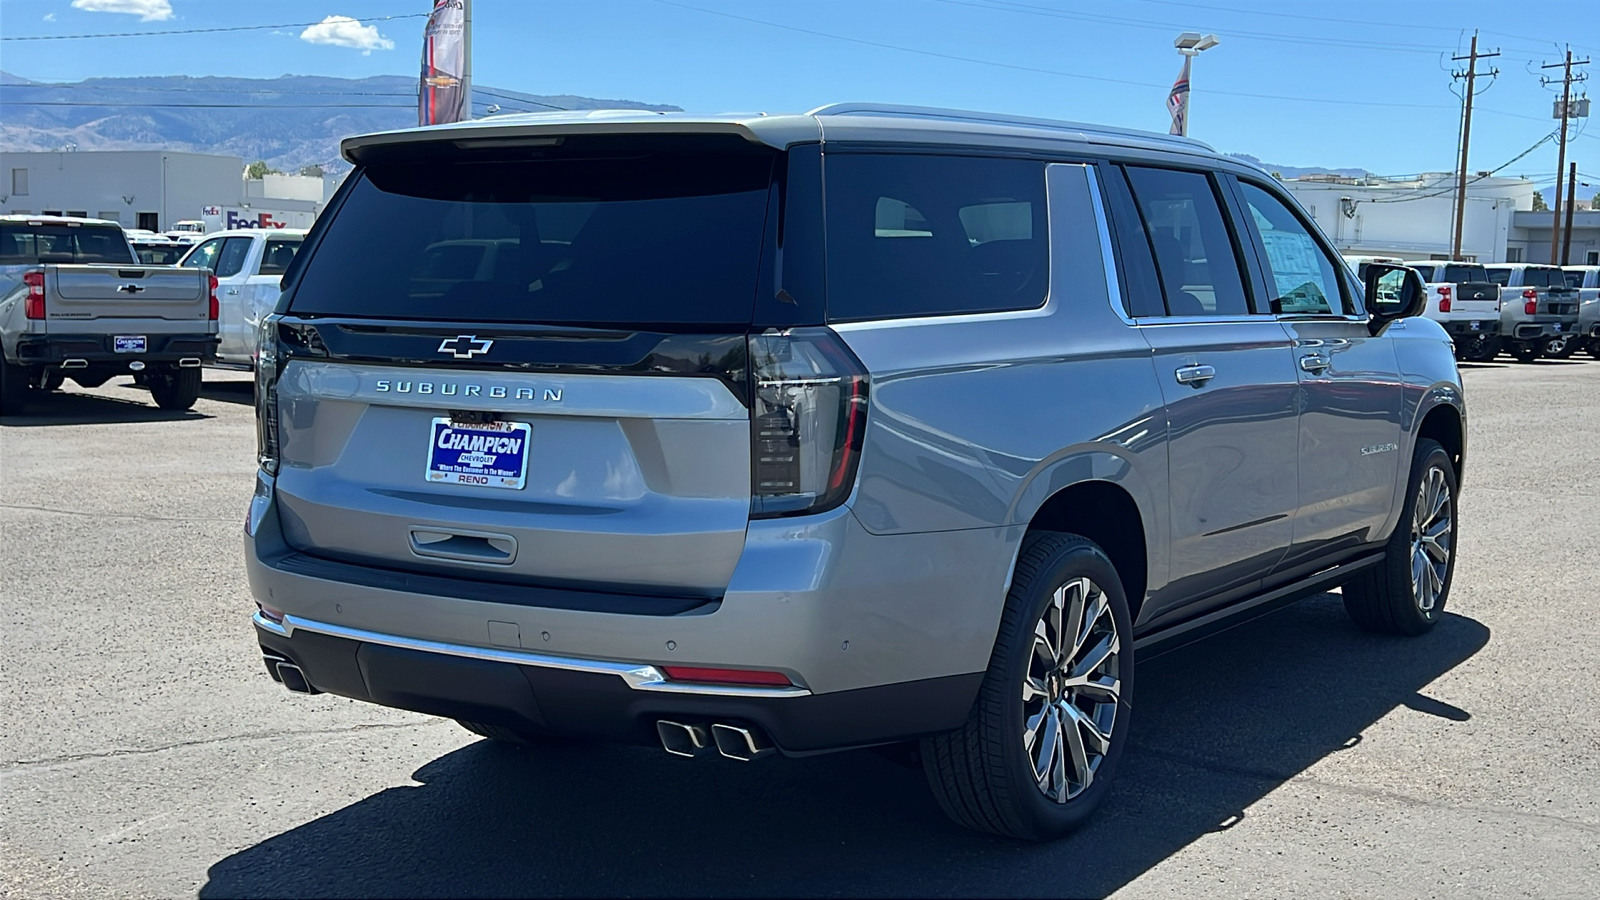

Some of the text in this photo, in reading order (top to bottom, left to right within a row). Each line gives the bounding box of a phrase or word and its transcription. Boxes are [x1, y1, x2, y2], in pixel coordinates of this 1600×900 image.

[203, 207, 219, 216] FedEx
[376, 380, 562, 401] SUBURBAN
[438, 429, 522, 455] CHAMPION
[460, 455, 494, 463] CHEVROLET
[462, 466, 484, 474] Customer
[458, 474, 489, 485] RENO
